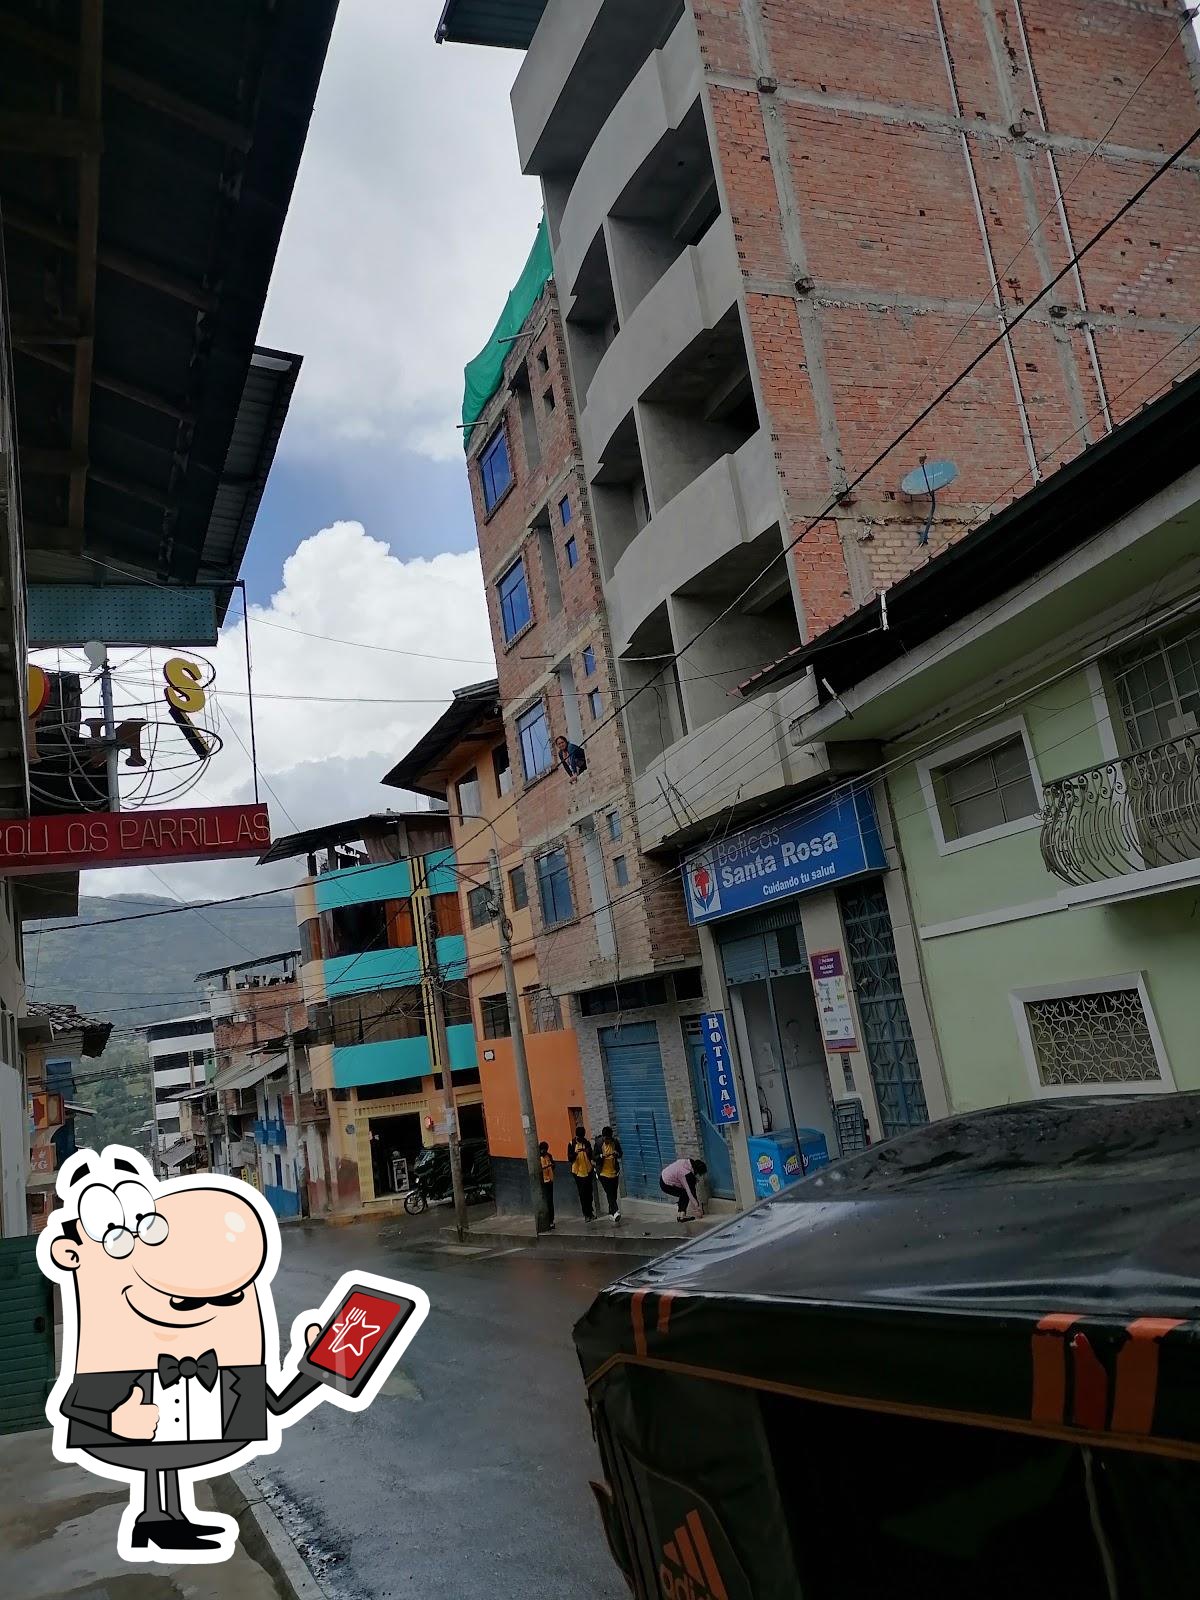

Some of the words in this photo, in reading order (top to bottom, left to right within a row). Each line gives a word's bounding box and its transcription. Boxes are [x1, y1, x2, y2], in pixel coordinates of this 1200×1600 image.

[0, 822, 109, 857] OLLOS
[119, 811, 271, 850] PARRILLAS
[718, 828, 780, 866] Boticas
[721, 854, 777, 888] Santa
[781, 832, 839, 867] Rosa
[763, 877, 799, 895] Cuidando
[800, 873, 810, 884] tu
[811, 863, 836, 880] salud
[707, 1017, 731, 1101] BOTICA
